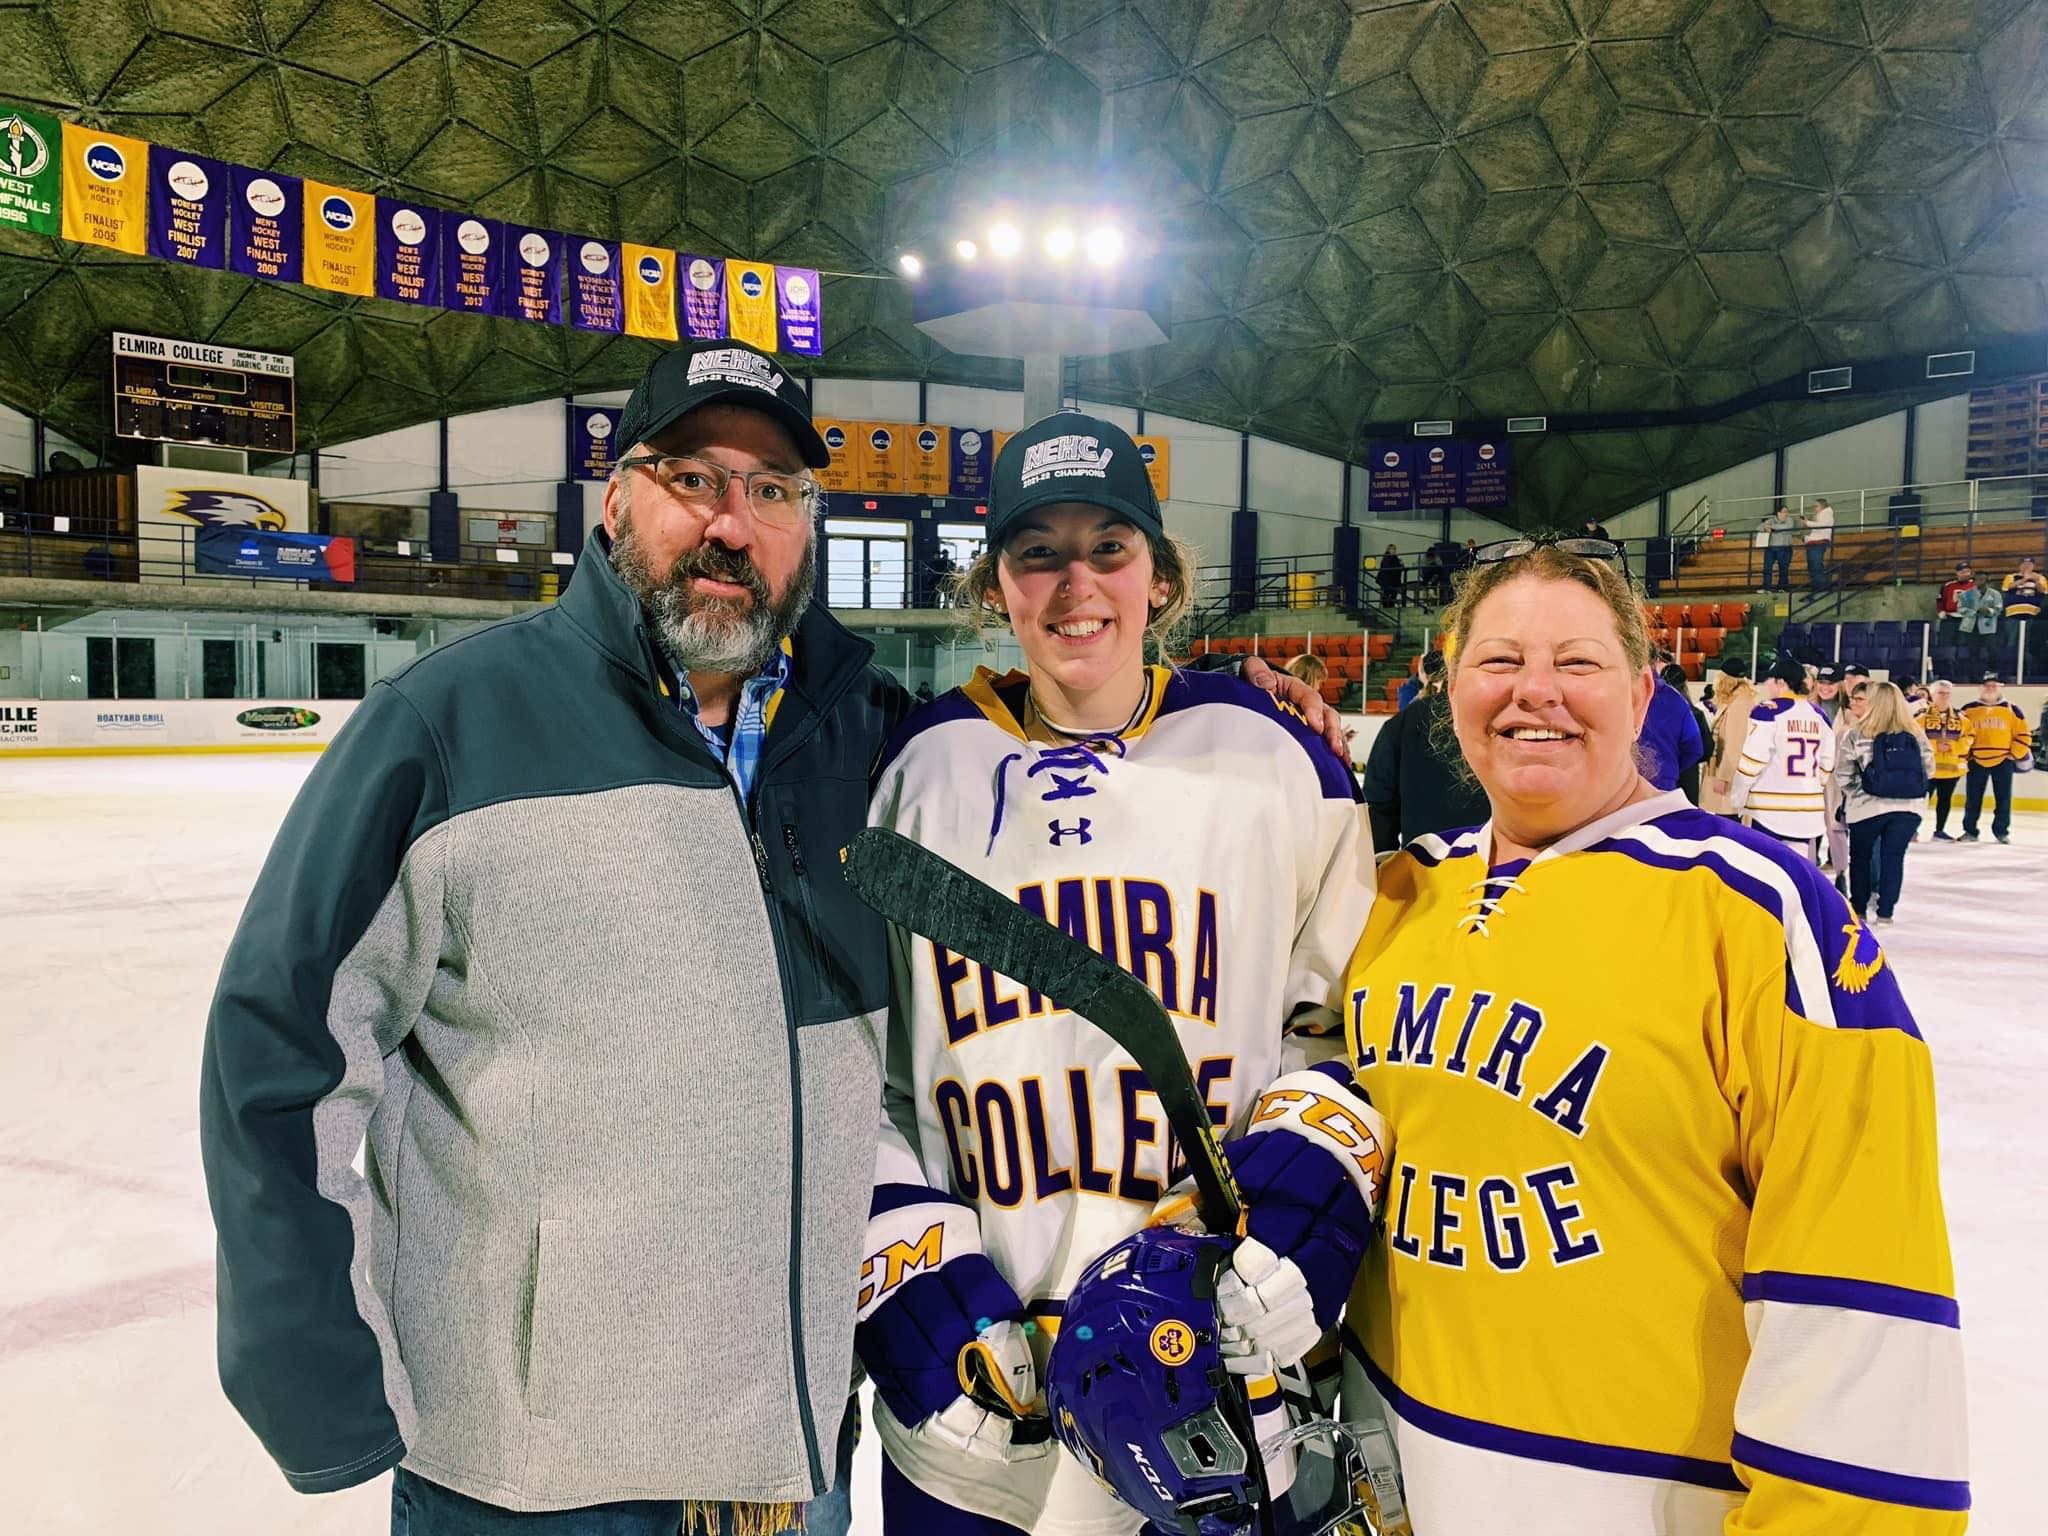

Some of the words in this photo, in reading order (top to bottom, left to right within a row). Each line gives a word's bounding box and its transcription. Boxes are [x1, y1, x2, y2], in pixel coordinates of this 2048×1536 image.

[88, 184, 123, 197] WOMEN'S
[91, 194, 120, 206] HOCKEY
[171, 198, 204, 212] WOMEN'S
[173, 208, 201, 220] HOCKEY
[84, 213, 125, 231] FINALIST
[173, 218, 200, 234] WEST
[93, 228, 116, 242] 2005
[168, 230, 206, 248] FINALIST
[252, 226, 280, 238] HOCKEY
[254, 236, 280, 250] WEST
[326, 243, 352, 254] HOCKEY
[177, 245, 199, 260] 2007
[246, 247, 288, 263] FINALIST
[397, 254, 421, 263] HOCKEY
[322, 260, 356, 275] FINALIST
[397, 263, 419, 275] WEST
[392, 273, 425, 288] FINALIST
[463, 272, 484, 283] WEST
[399, 287, 419, 299] 2010
[456, 283, 490, 296] FINALIST
[523, 286, 543, 297] WEST
[579, 283, 615, 294] HOCKEY
[518, 297, 549, 309] FINALIST
[582, 293, 614, 305] WEST
[580, 304, 616, 318] FINALIST
[688, 305, 718, 316] WEST
[586, 315, 612, 328] 2015
[687, 317, 721, 329] FINALIST
[119, 337, 166, 356] ELMIRA
[173, 345, 224, 364] COLLEGE
[232, 359, 261, 370] SOARING
[266, 364, 290, 374] EAGLES
[688, 349, 771, 379] NEHC
[125, 385, 158, 396] ELMIRA
[250, 401, 285, 411] VISITOR
[1023, 435, 1100, 473] NEHC
[1054, 469, 1106, 478] CHAMPIONS
[97, 714, 140, 722] BOATYARD
[142, 714, 164, 722] GRILL
[1787, 720, 1819, 734] MILLIN
[1787, 737, 1820, 777] 27
[929, 876, 1219, 1049] ELMIRA
[1350, 981, 1612, 1140] LMIRA
[931, 1054, 1236, 1210] COLLEE
[1391, 1161, 1605, 1274] LEGE
[1126, 1442, 1174, 1502] CCM
